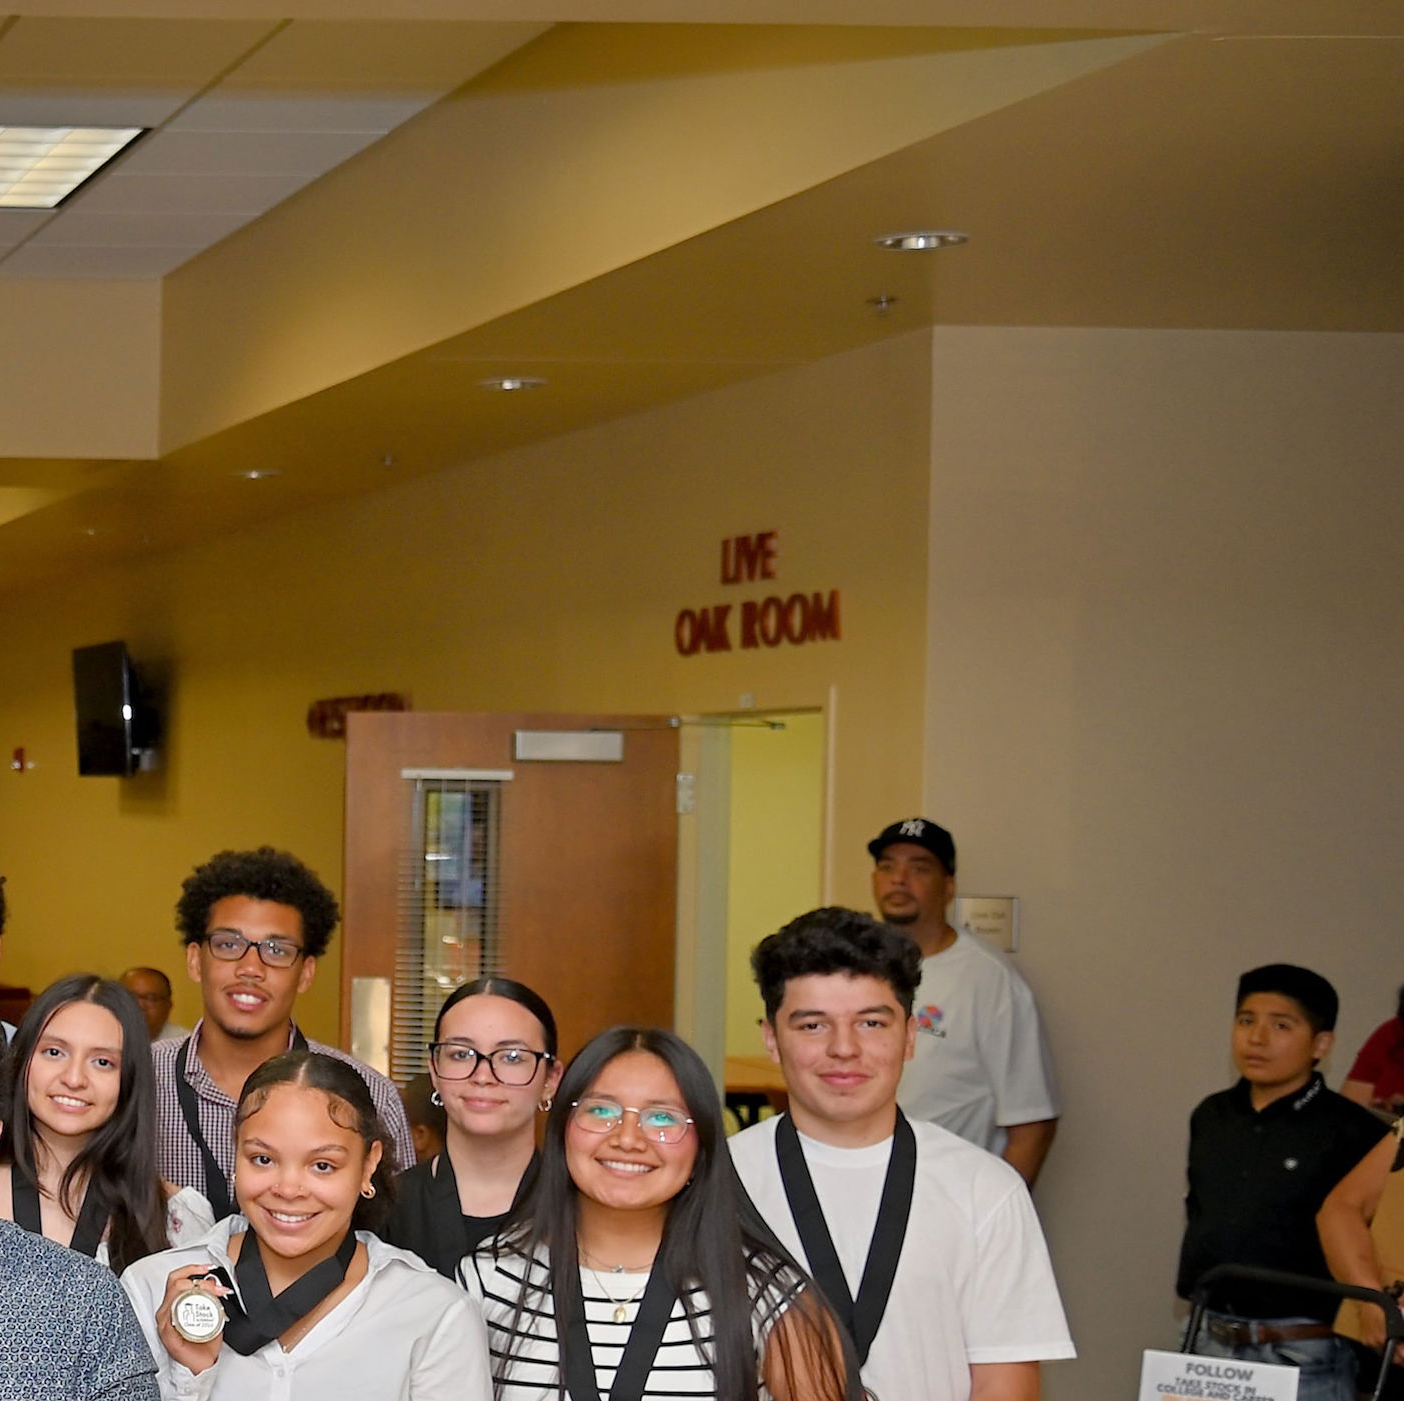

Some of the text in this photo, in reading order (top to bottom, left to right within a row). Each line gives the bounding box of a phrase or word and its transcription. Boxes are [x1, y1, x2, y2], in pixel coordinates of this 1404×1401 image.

[721, 531, 778, 585] LIVE
[675, 589, 841, 657] OAK ROOM
[1186, 1363, 1254, 1381] FOLLOW
[1175, 1377, 1257, 1395] TAKE STOCK IN
[1207, 1390, 1231, 1401] AND
